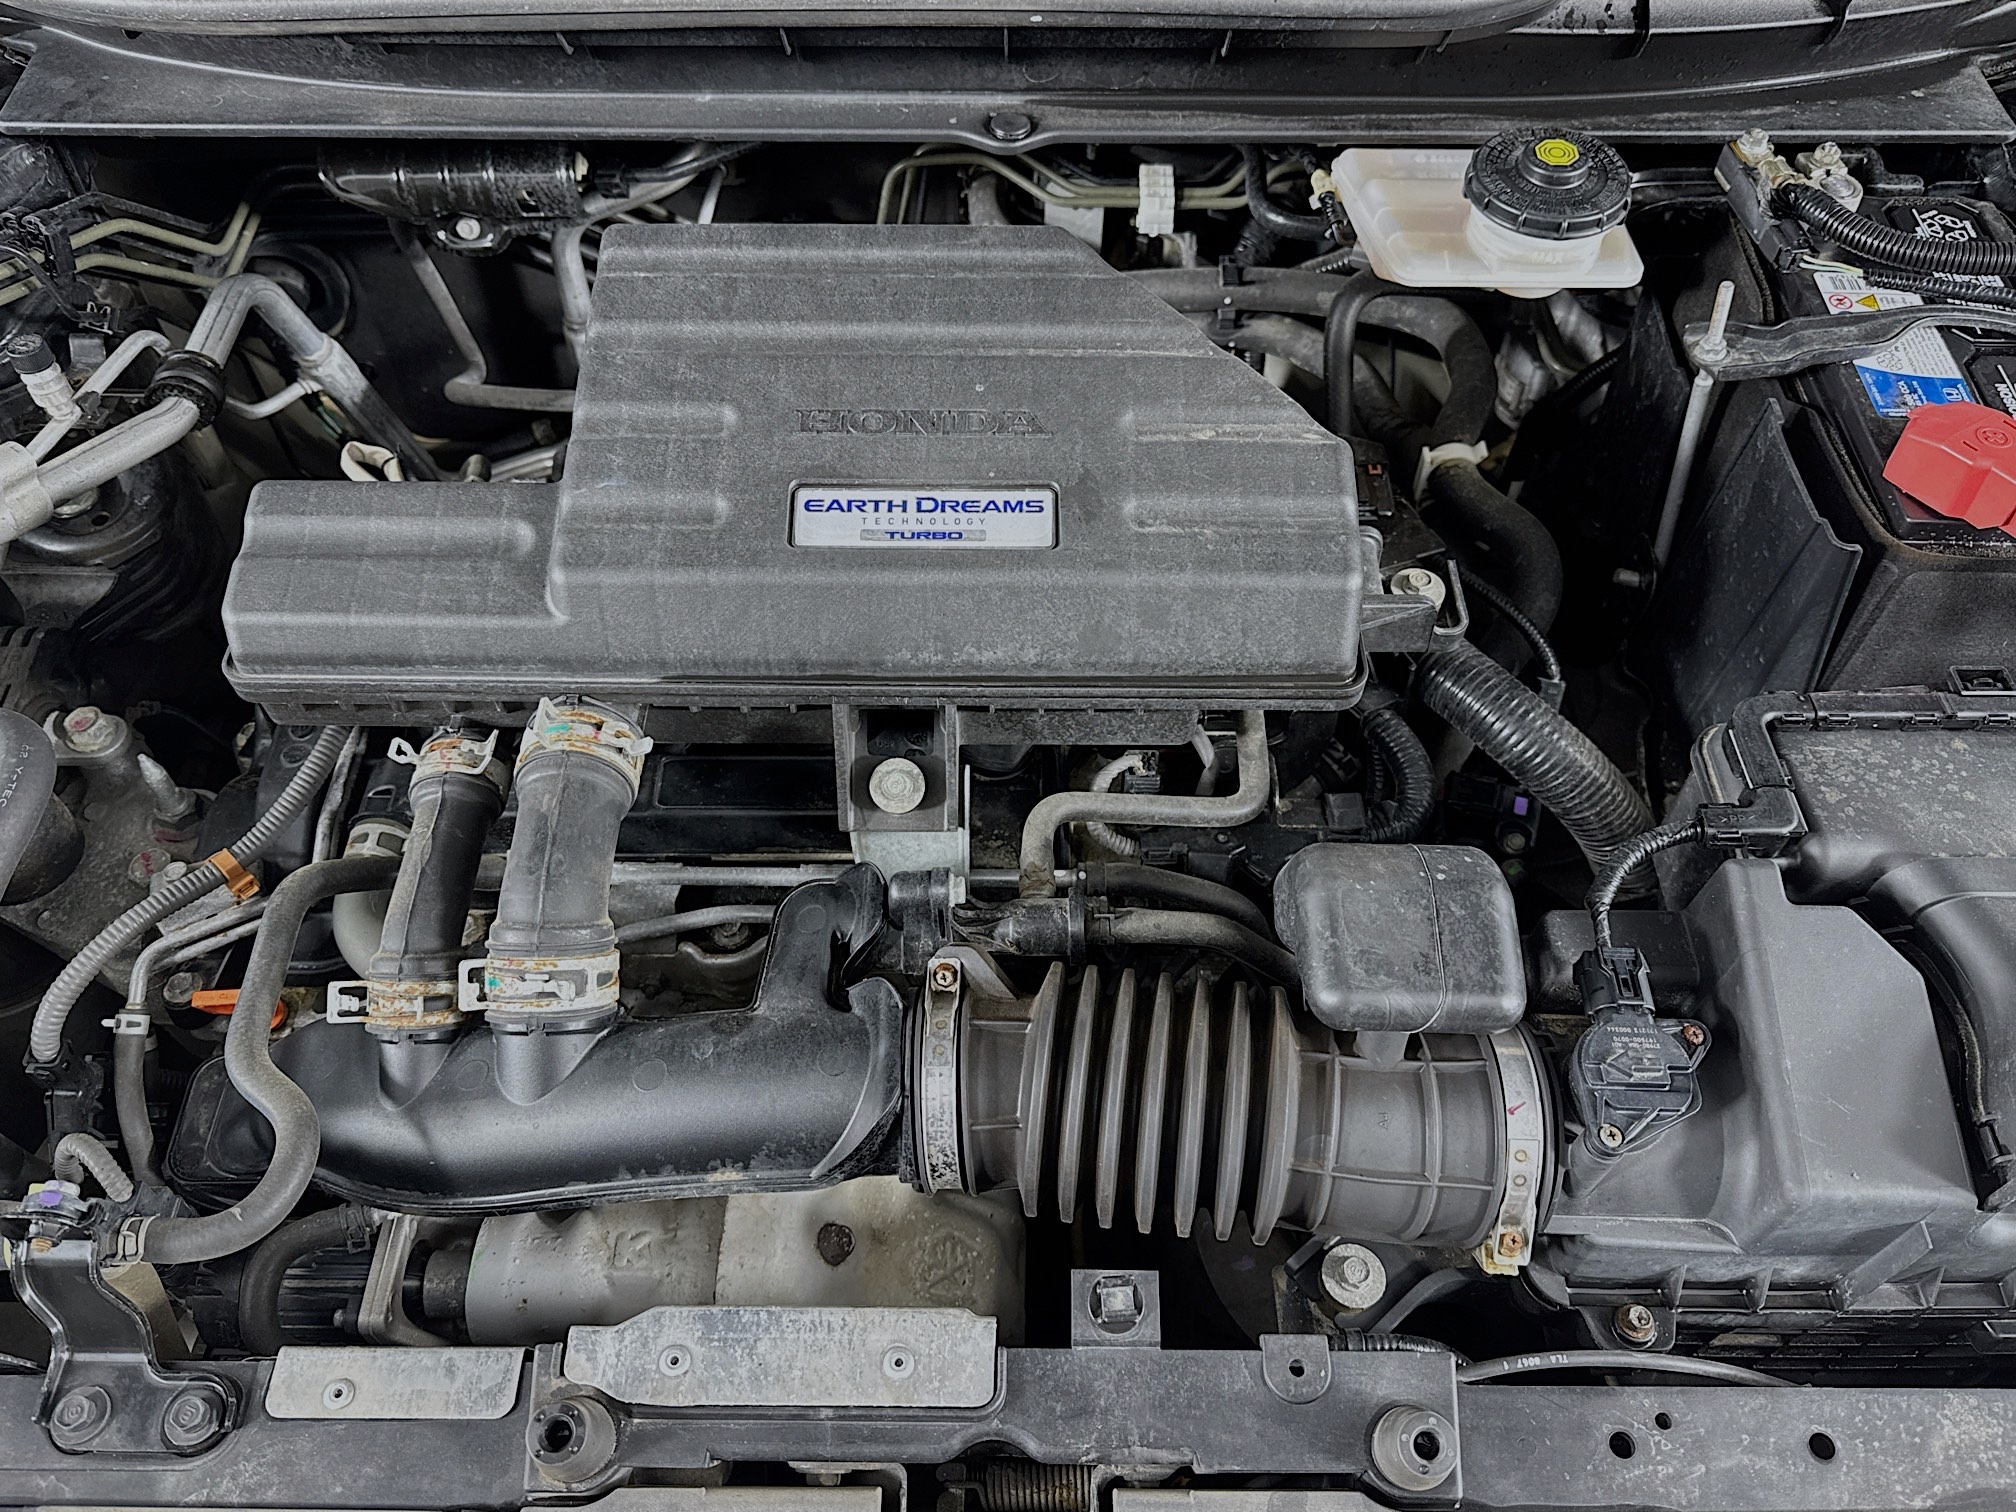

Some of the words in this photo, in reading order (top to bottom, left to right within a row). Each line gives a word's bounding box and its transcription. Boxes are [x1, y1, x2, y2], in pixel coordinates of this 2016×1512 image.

[1531, 252, 1563, 264] MAX
[793, 409, 1052, 437] HONDA
[803, 498, 908, 514] EARTH
[915, 496, 1045, 514] DREAMS
[861, 517, 987, 526] TECHNOLOGY
[884, 531, 964, 540] TURBO
[1550, 1355, 1569, 1363] TLA
